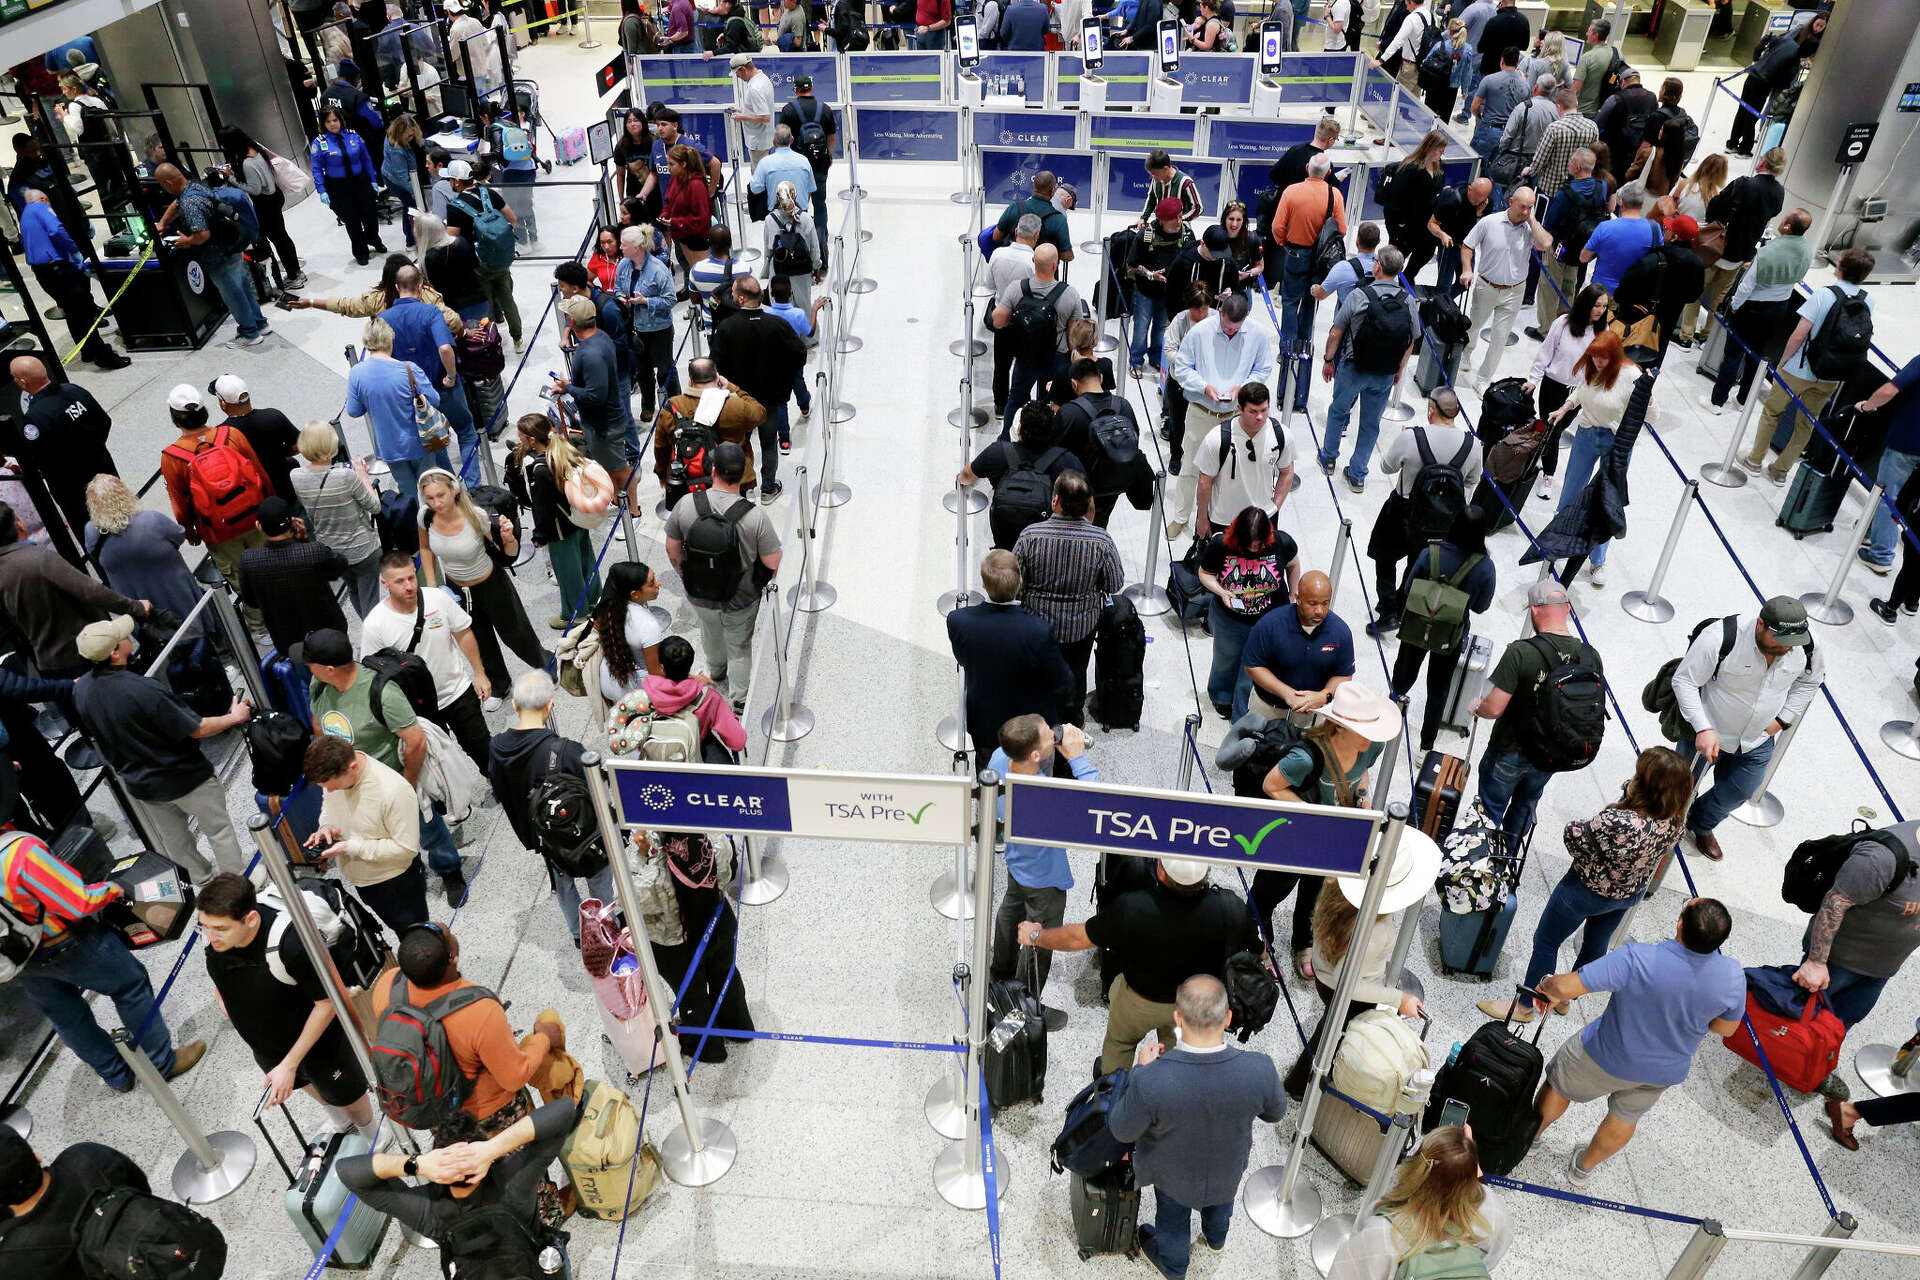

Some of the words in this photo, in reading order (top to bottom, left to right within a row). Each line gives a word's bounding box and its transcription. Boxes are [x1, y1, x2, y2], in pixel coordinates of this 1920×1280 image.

[328, 97, 342, 109] TSA
[1017, 134, 1048, 143] CLEAR
[65, 400, 88, 421] TSA
[687, 792, 763, 809] CLEAR
[860, 792, 894, 802] WITH
[739, 808, 763, 816] PLUS
[825, 803, 865, 820] TSA
[872, 805, 906, 822] Pre
[1087, 808, 1158, 841] TSA
[1168, 817, 1231, 848] Pre
[1491, 1178, 1515, 1187] UNITED
[1591, 1200, 1618, 1209] UNITED
